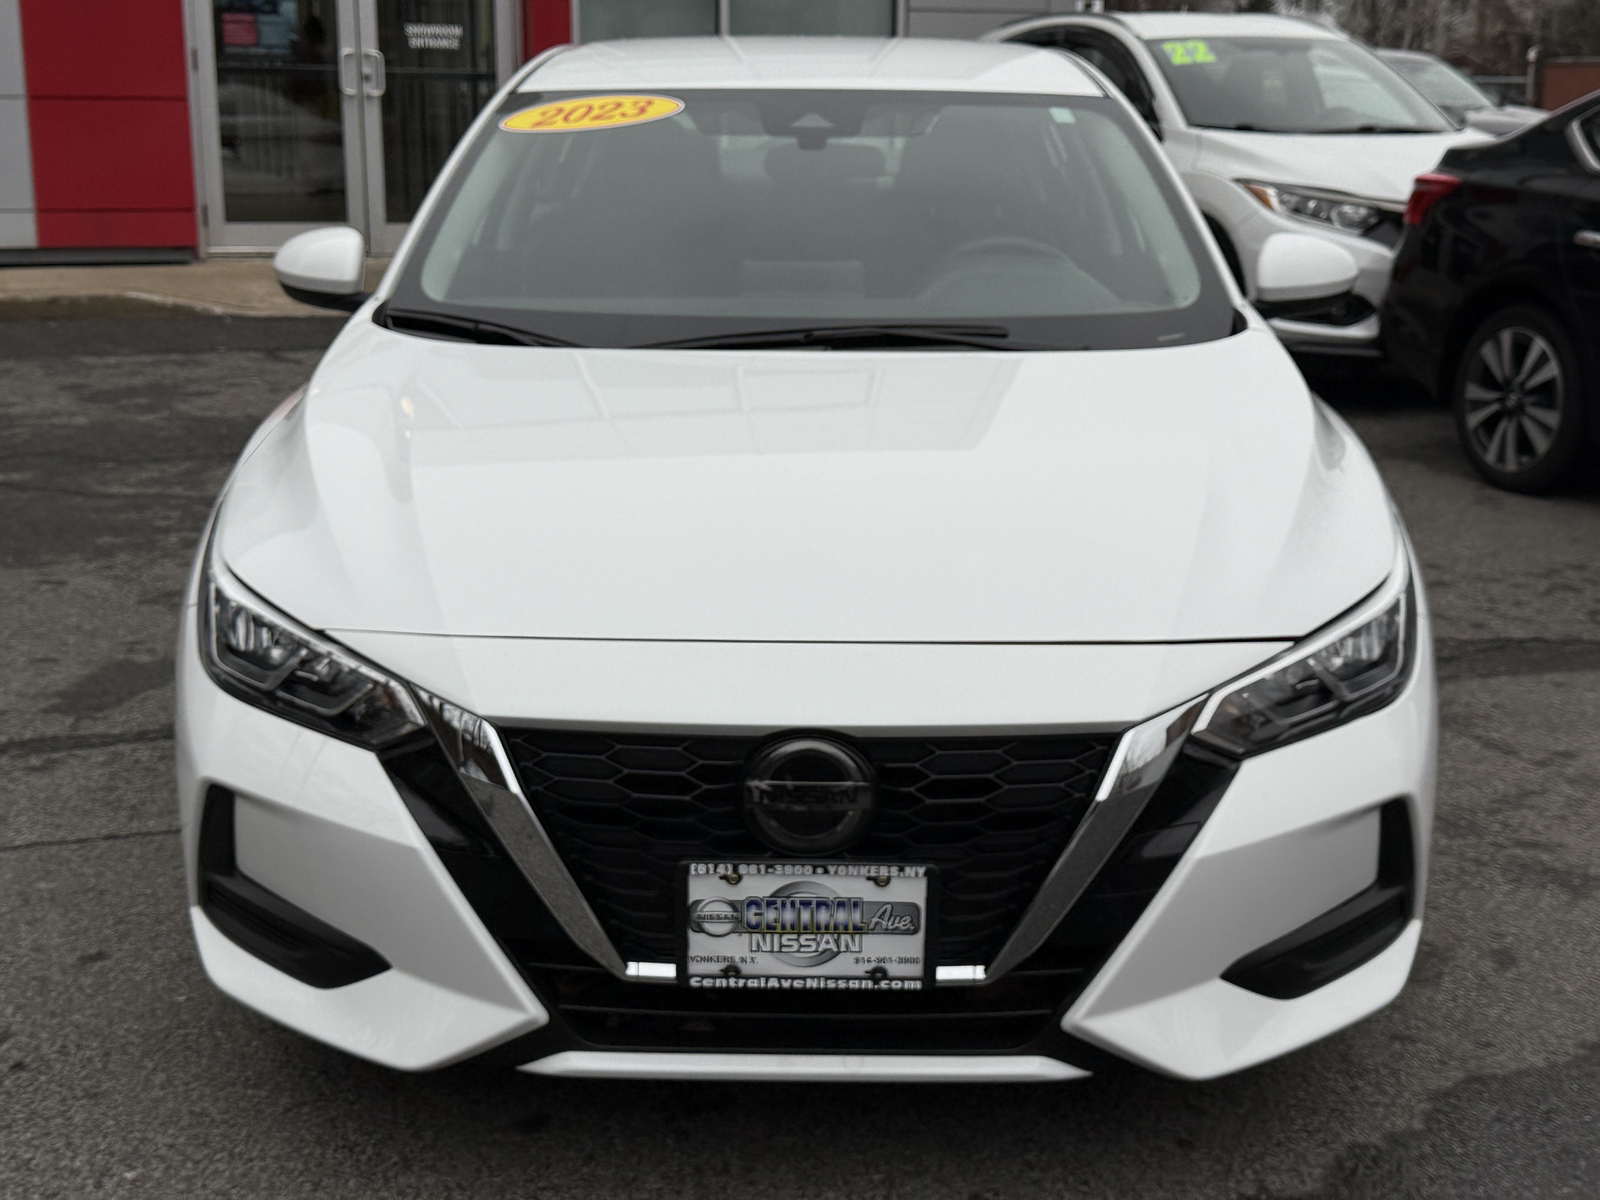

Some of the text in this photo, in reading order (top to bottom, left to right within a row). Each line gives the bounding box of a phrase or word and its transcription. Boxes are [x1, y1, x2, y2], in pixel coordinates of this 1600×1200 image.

[1162, 41, 1216, 65] 22
[530, 99, 655, 128] 2023
[743, 897, 867, 933] CENTRAL
[750, 933, 862, 952] NISSAN
[689, 977, 923, 990] CentralAveNissan.com
